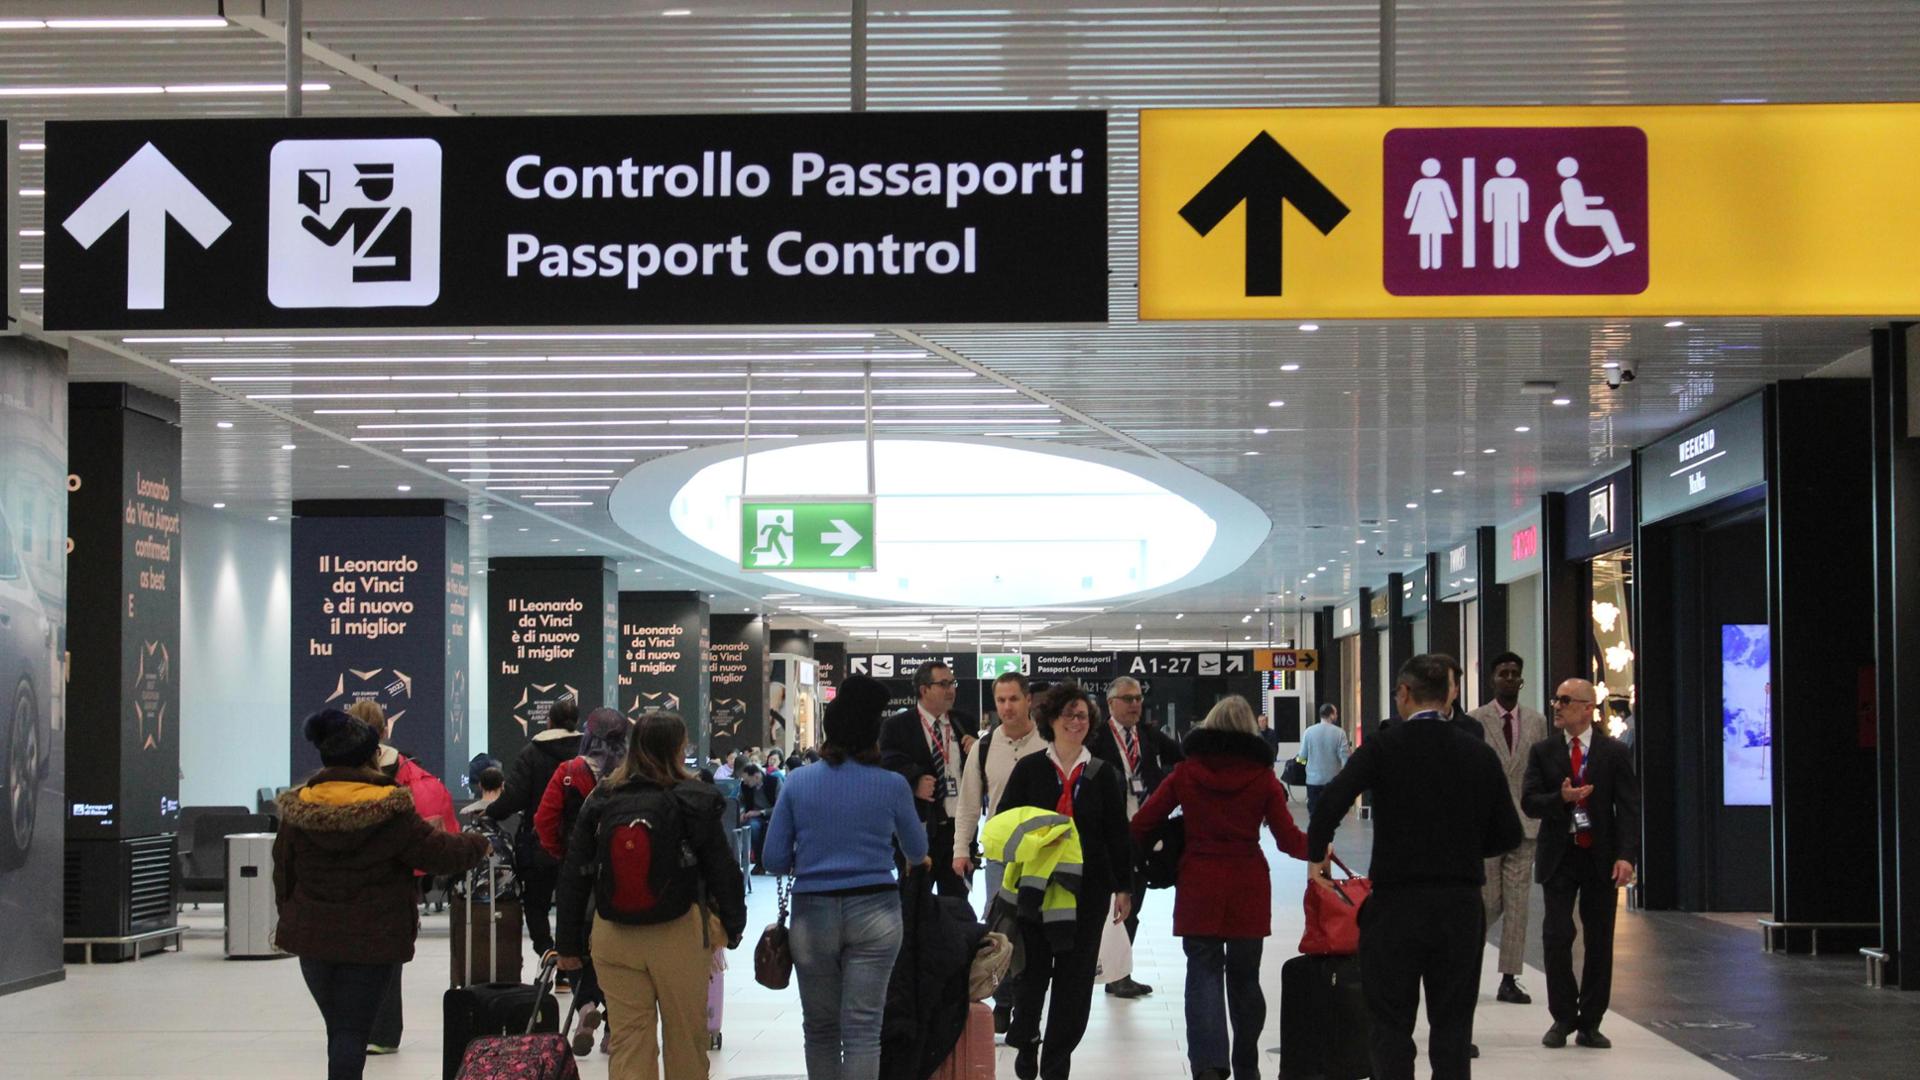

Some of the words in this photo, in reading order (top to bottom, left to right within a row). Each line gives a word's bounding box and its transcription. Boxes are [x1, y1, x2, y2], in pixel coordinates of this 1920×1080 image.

[505, 150, 771, 199] Controllo
[790, 147, 1085, 208] Passaporti
[505, 232, 749, 290] Passport
[766, 226, 977, 276] Control
[1679, 429, 1715, 463] WEEKEND
[137, 471, 170, 502] Leonardo
[126, 499, 136, 525] da
[136, 502, 155, 529] Vinci
[155, 507, 180, 538] Airport
[135, 535, 170, 562] confirmed
[320, 555, 330, 573] Il
[334, 555, 418, 573] Leonardo
[141, 571, 150, 589] as
[150, 565, 166, 592] best
[332, 576, 356, 594] da
[360, 576, 404, 594] Vinci
[128, 592, 135, 618] E
[323, 597, 334, 614] è
[338, 597, 355, 614] di
[360, 601, 414, 614] nuovo
[509, 599, 516, 612] Il
[520, 598, 583, 612] Leonardo
[519, 614, 536, 628] da
[540, 614, 573, 628] Vinci
[330, 617, 341, 635] il
[344, 617, 407, 640] miglior
[624, 624, 630, 636] Il
[633, 624, 683, 635] Leonardo
[512, 630, 520, 643] è
[523, 630, 536, 643] di
[539, 633, 580, 643] nuovo
[632, 637, 646, 648] da
[648, 637, 675, 648] Vinci
[310, 639, 333, 656] hu
[517, 645, 526, 659] il
[528, 645, 575, 662] miglior
[626, 650, 634, 660] è
[635, 649, 646, 660] di
[648, 652, 680, 660] nuovo
[720, 653, 742, 662] Vinci
[1073, 656, 1111, 664] Passaporti
[502, 661, 520, 675] hu
[630, 662, 637, 673] il
[640, 662, 677, 675] miglior
[709, 663, 718, 672] di
[901, 667, 917, 675] Gat
[1038, 666, 1069, 674] Passport
[618, 674, 632, 685] hu
[712, 673, 743, 684] miglior
[1083, 682, 1112, 693] A21-2
[888, 695, 916, 705] archi
